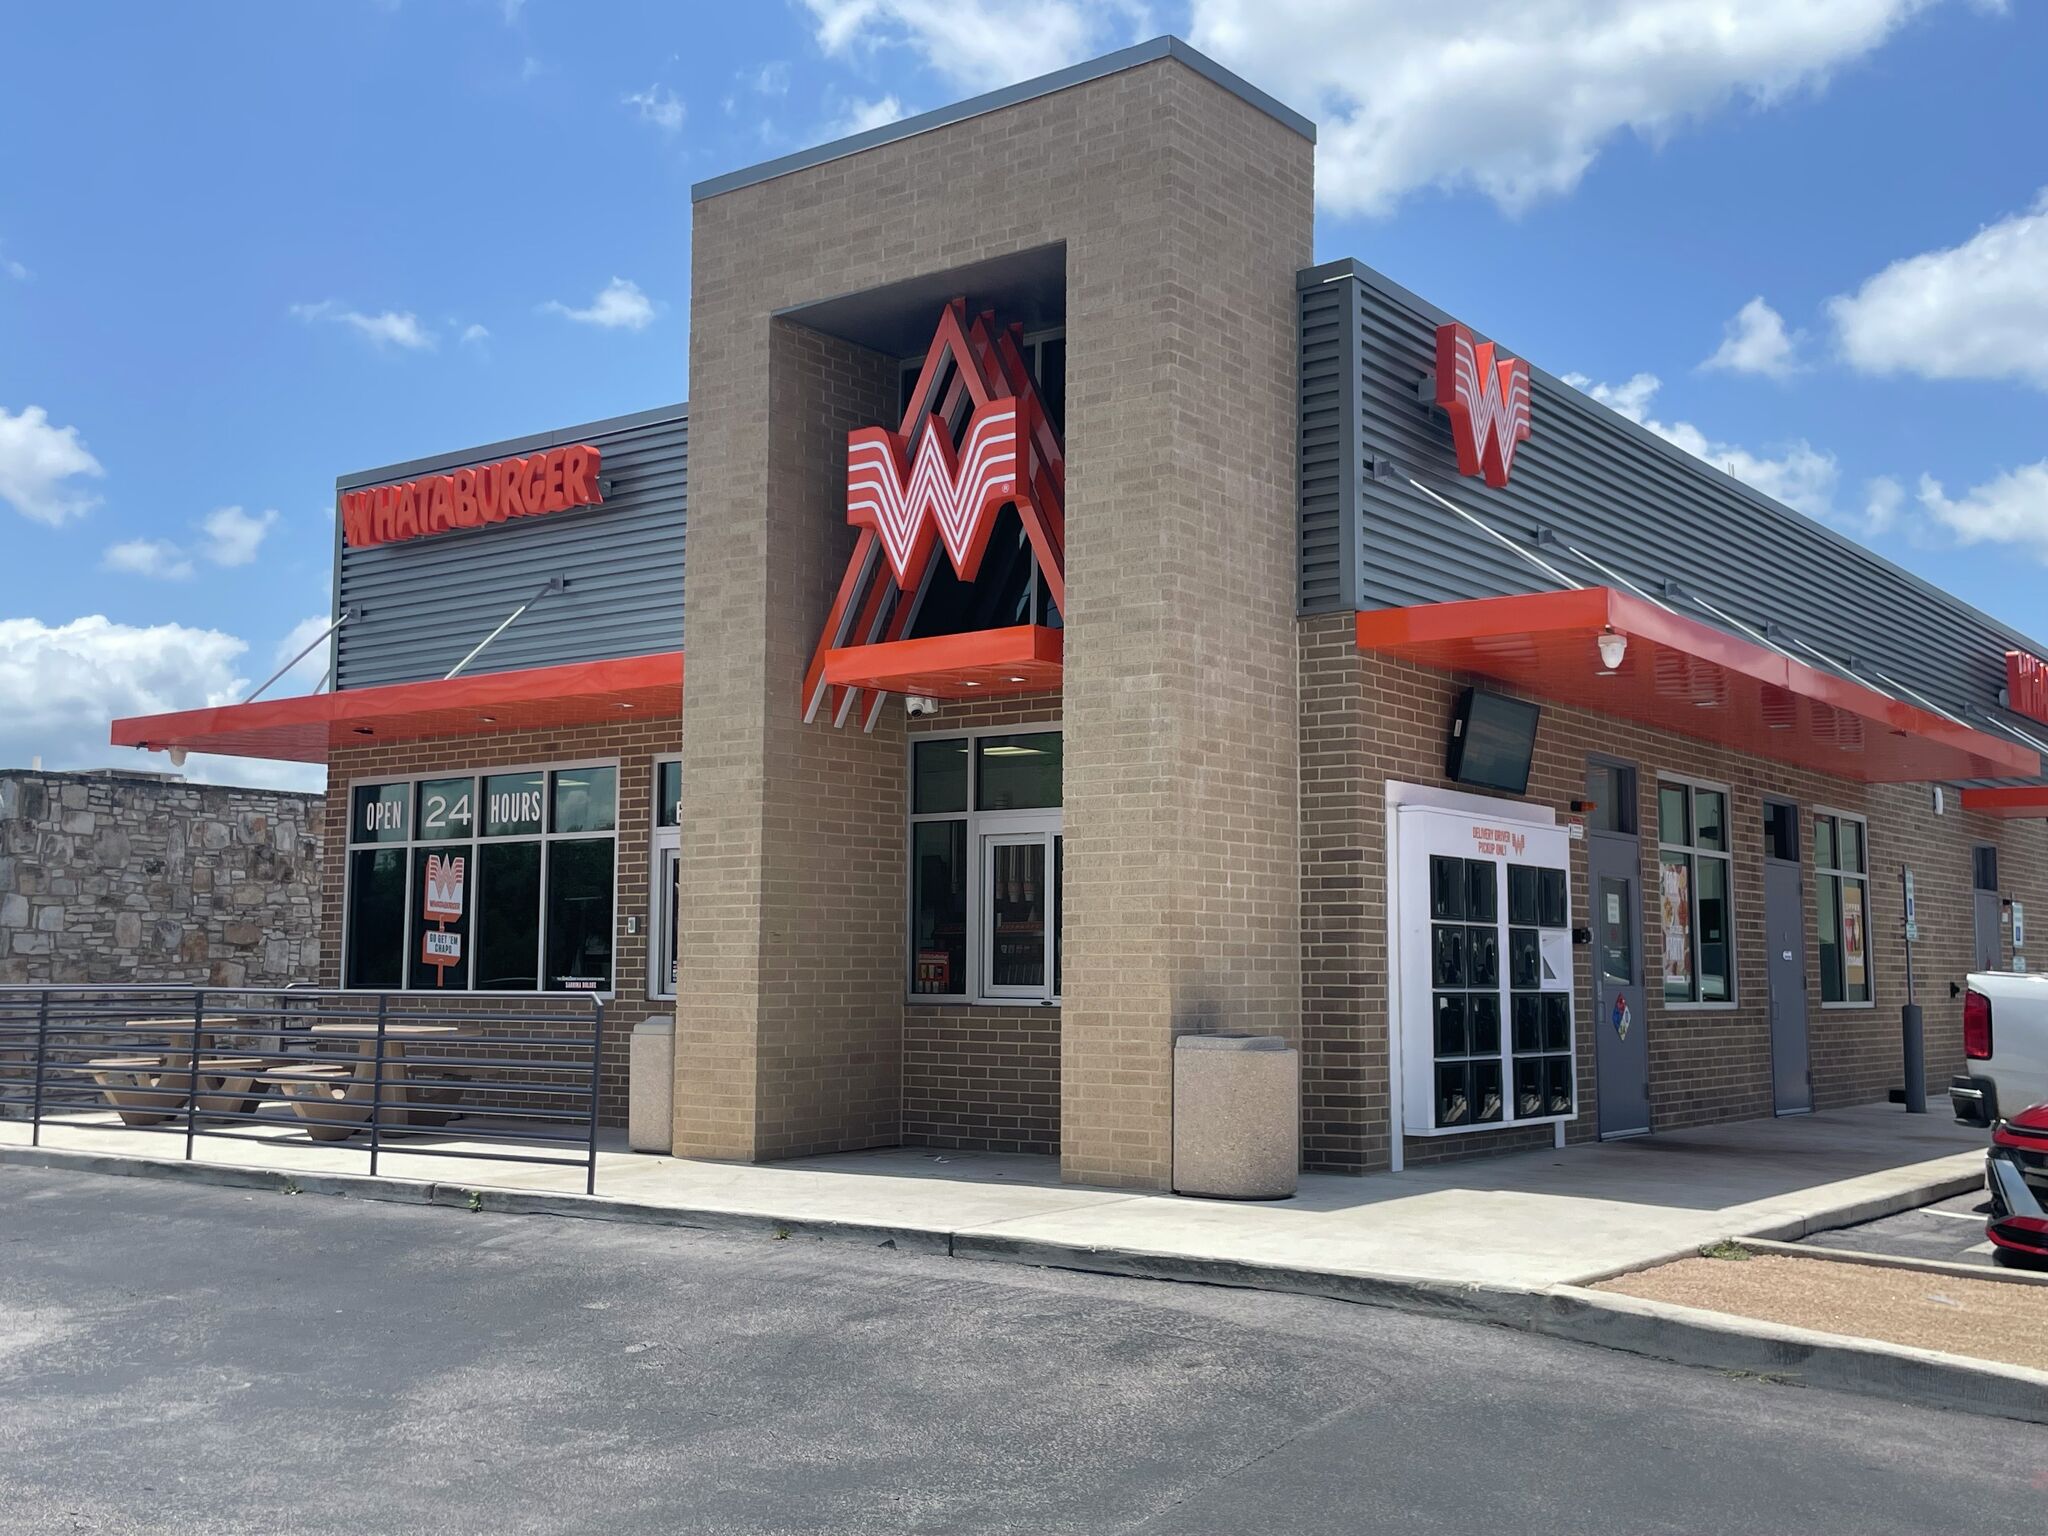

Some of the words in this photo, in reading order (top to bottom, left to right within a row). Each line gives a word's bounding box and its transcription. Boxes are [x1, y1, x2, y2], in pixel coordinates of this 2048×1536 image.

[341, 445, 602, 547] WHATABURGER
[847, 396, 1024, 591] W
[366, 801, 402, 831] OPEN
[425, 794, 472, 828] 24
[490, 791, 541, 824] HOURS
[1472, 826, 1494, 840] DELIVERY
[1494, 829, 1511, 843] DRIVER
[1478, 841, 1495, 855] PICKUP
[429, 933, 437, 943] GO
[437, 934, 448, 944] GET
